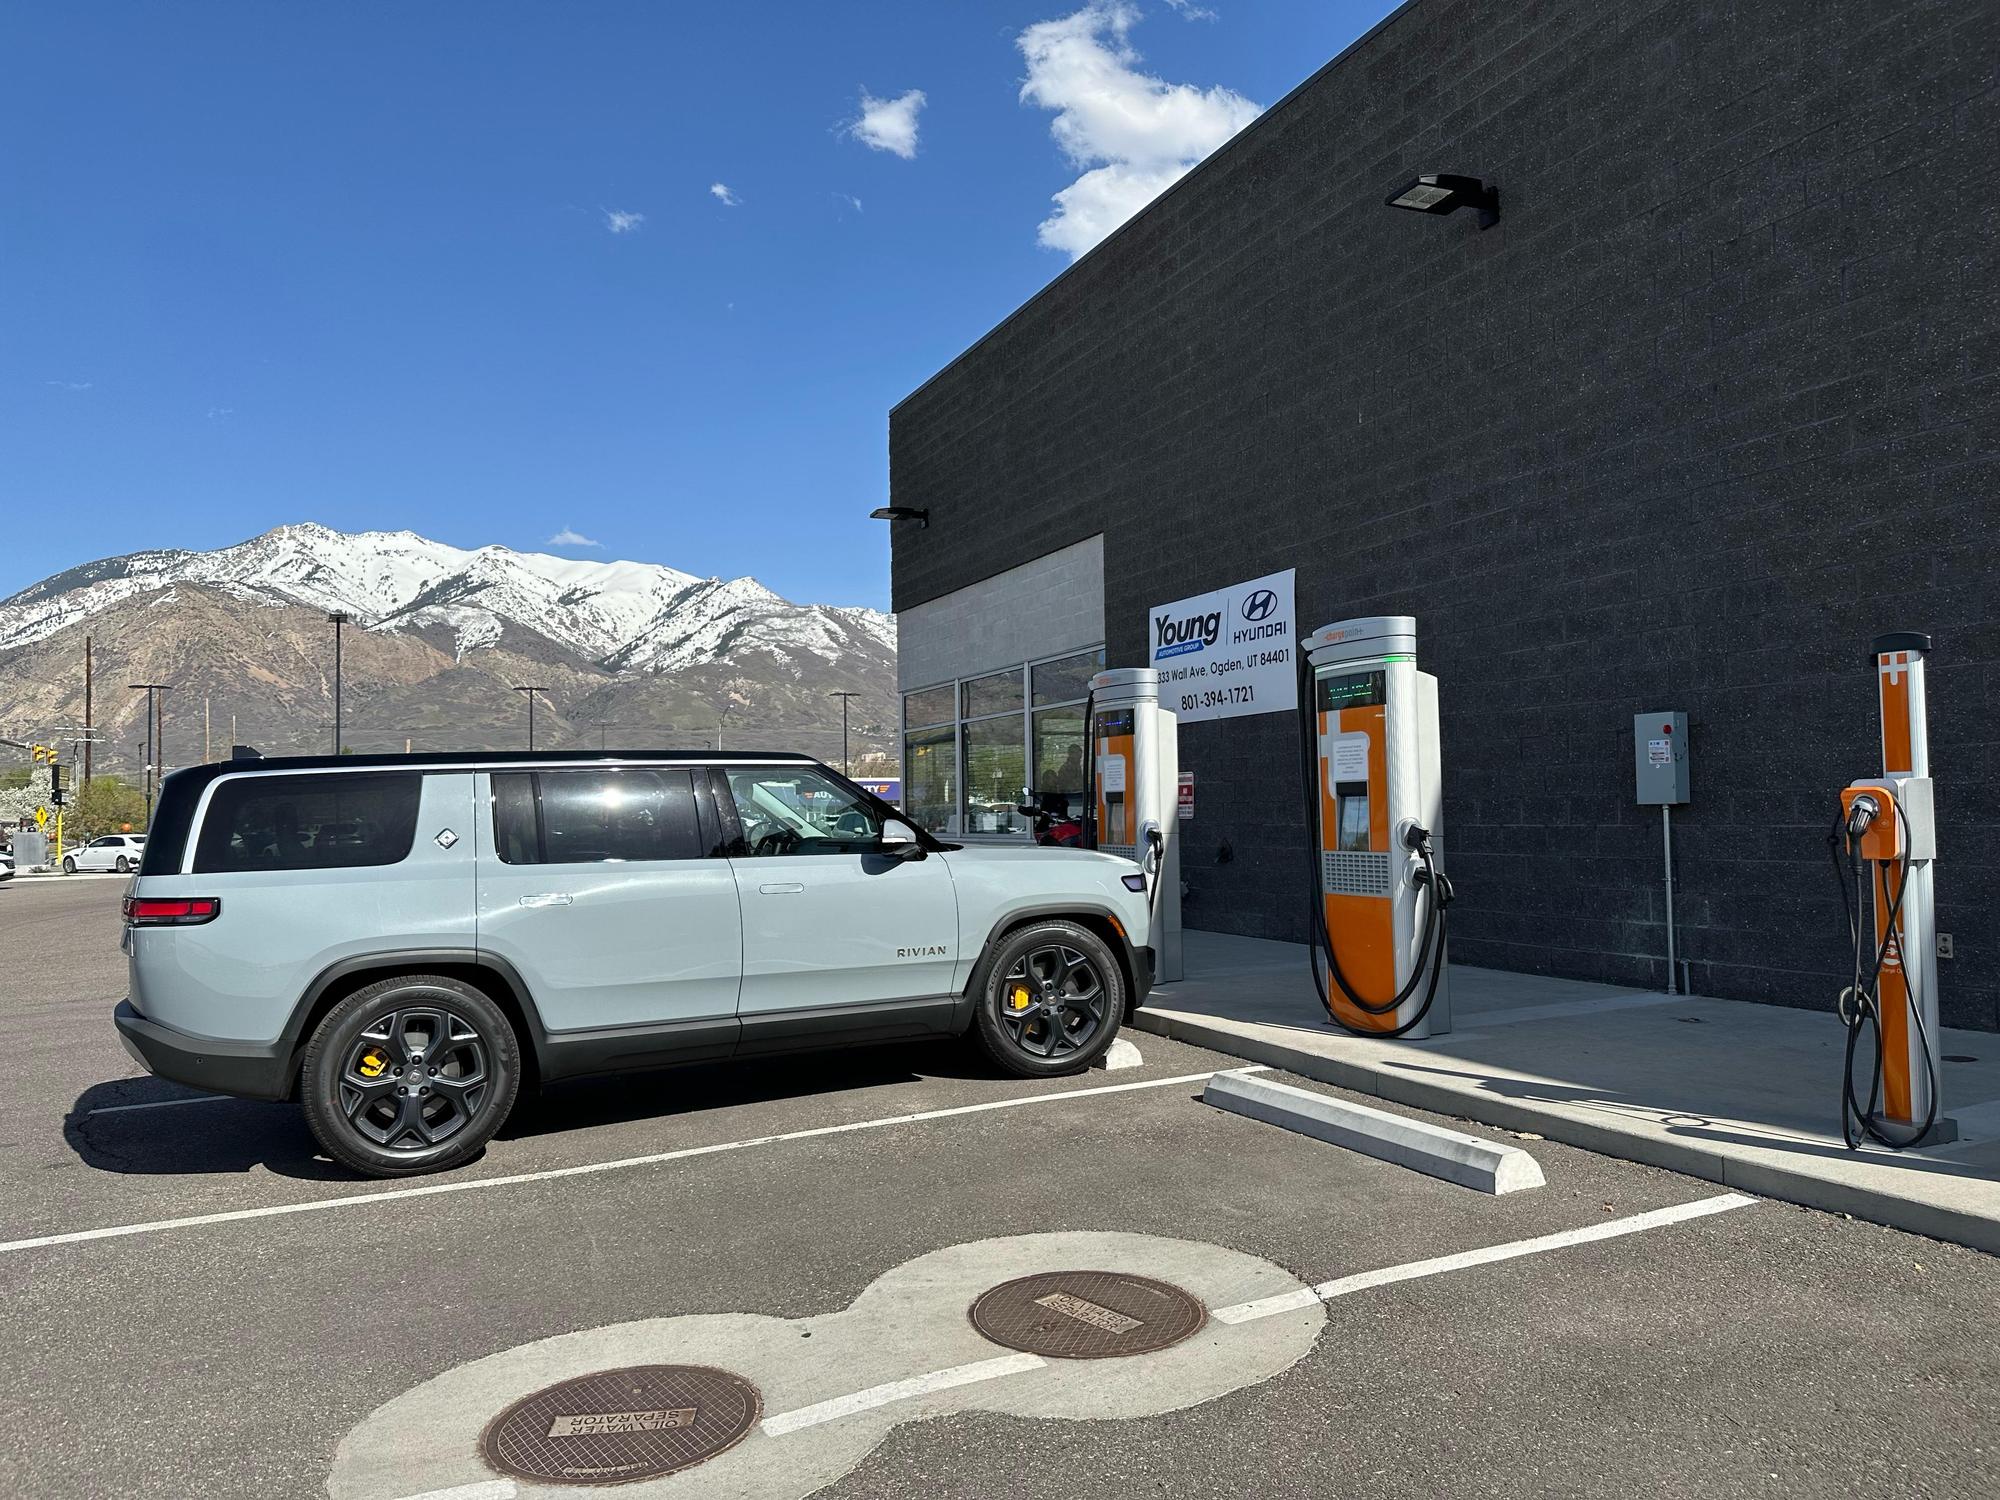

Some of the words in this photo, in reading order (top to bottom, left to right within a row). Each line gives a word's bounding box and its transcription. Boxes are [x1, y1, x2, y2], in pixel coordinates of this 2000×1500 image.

[1155, 611, 1222, 647] Young
[1233, 621, 1287, 645] HYUNDAI
[1171, 667, 1188, 681] Wall
[1190, 665, 1208, 679] Ave,
[1210, 659, 1244, 676] Ogden,
[1247, 654, 1258, 668] UT
[1260, 648, 1289, 666] 84401
[1181, 685, 1254, 711] 801-394-1721
[896, 945, 947, 958] RIVIAN
[1045, 1301, 1119, 1330] SEPARATOR
[1085, 1305, 1129, 1325] WATER
[570, 1410, 680, 1426] SEPARATOR
[570, 1423, 634, 1435] WATER
[650, 1419, 679, 1429] OIL
